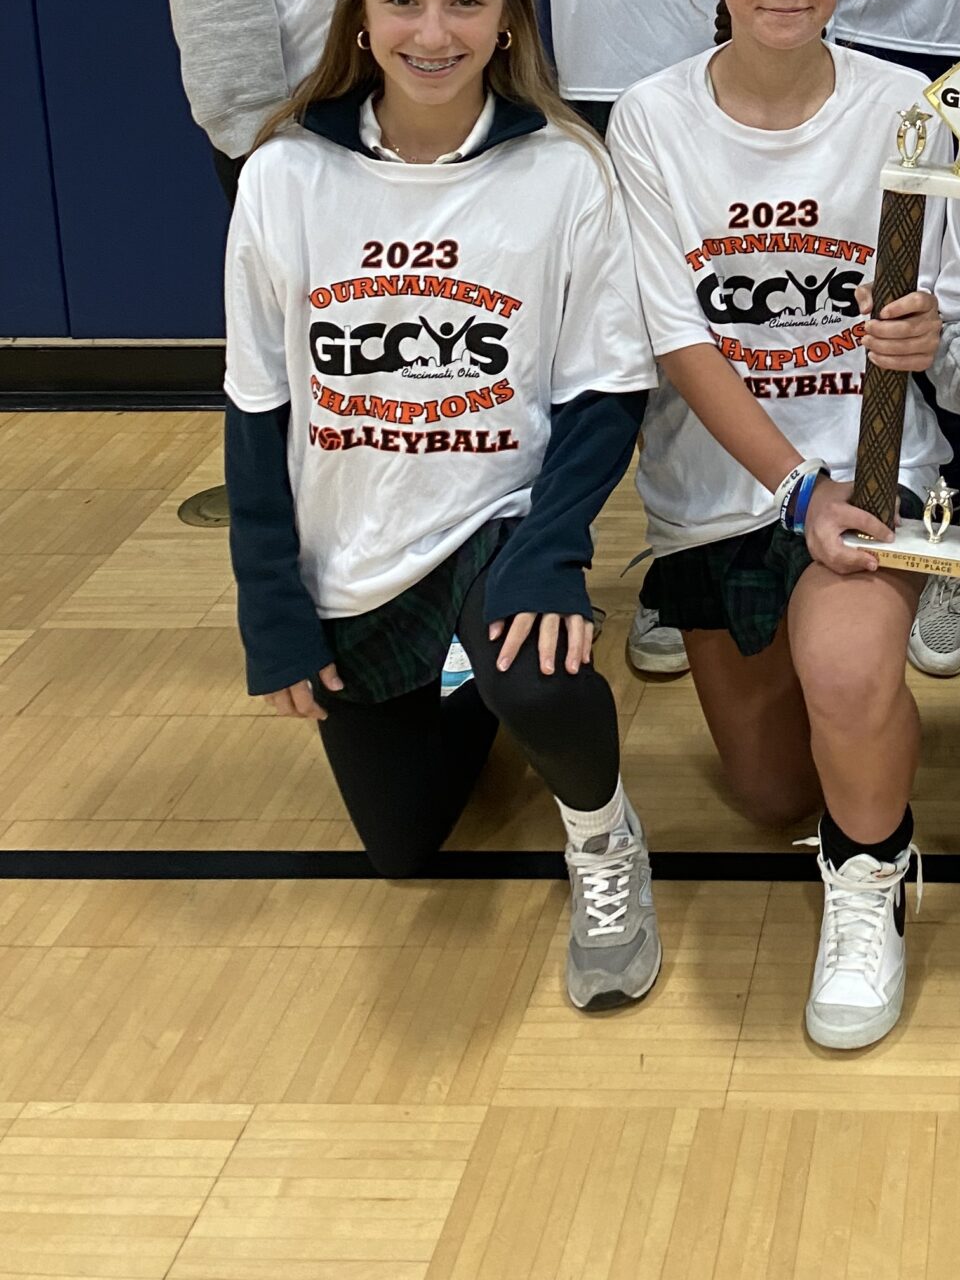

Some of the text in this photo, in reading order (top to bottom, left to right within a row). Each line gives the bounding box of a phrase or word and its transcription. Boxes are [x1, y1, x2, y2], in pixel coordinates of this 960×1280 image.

[728, 200, 819, 228] 2023
[361, 240, 459, 269] 2023
[309, 275, 522, 318] OURNAMENT
[821, 315, 842, 325] Ohio
[309, 315, 509, 376] GCCYS
[708, 321, 866, 371] HAMPIONS
[457, 367, 480, 378] Ohio
[924, 564, 952, 574] PLACE
